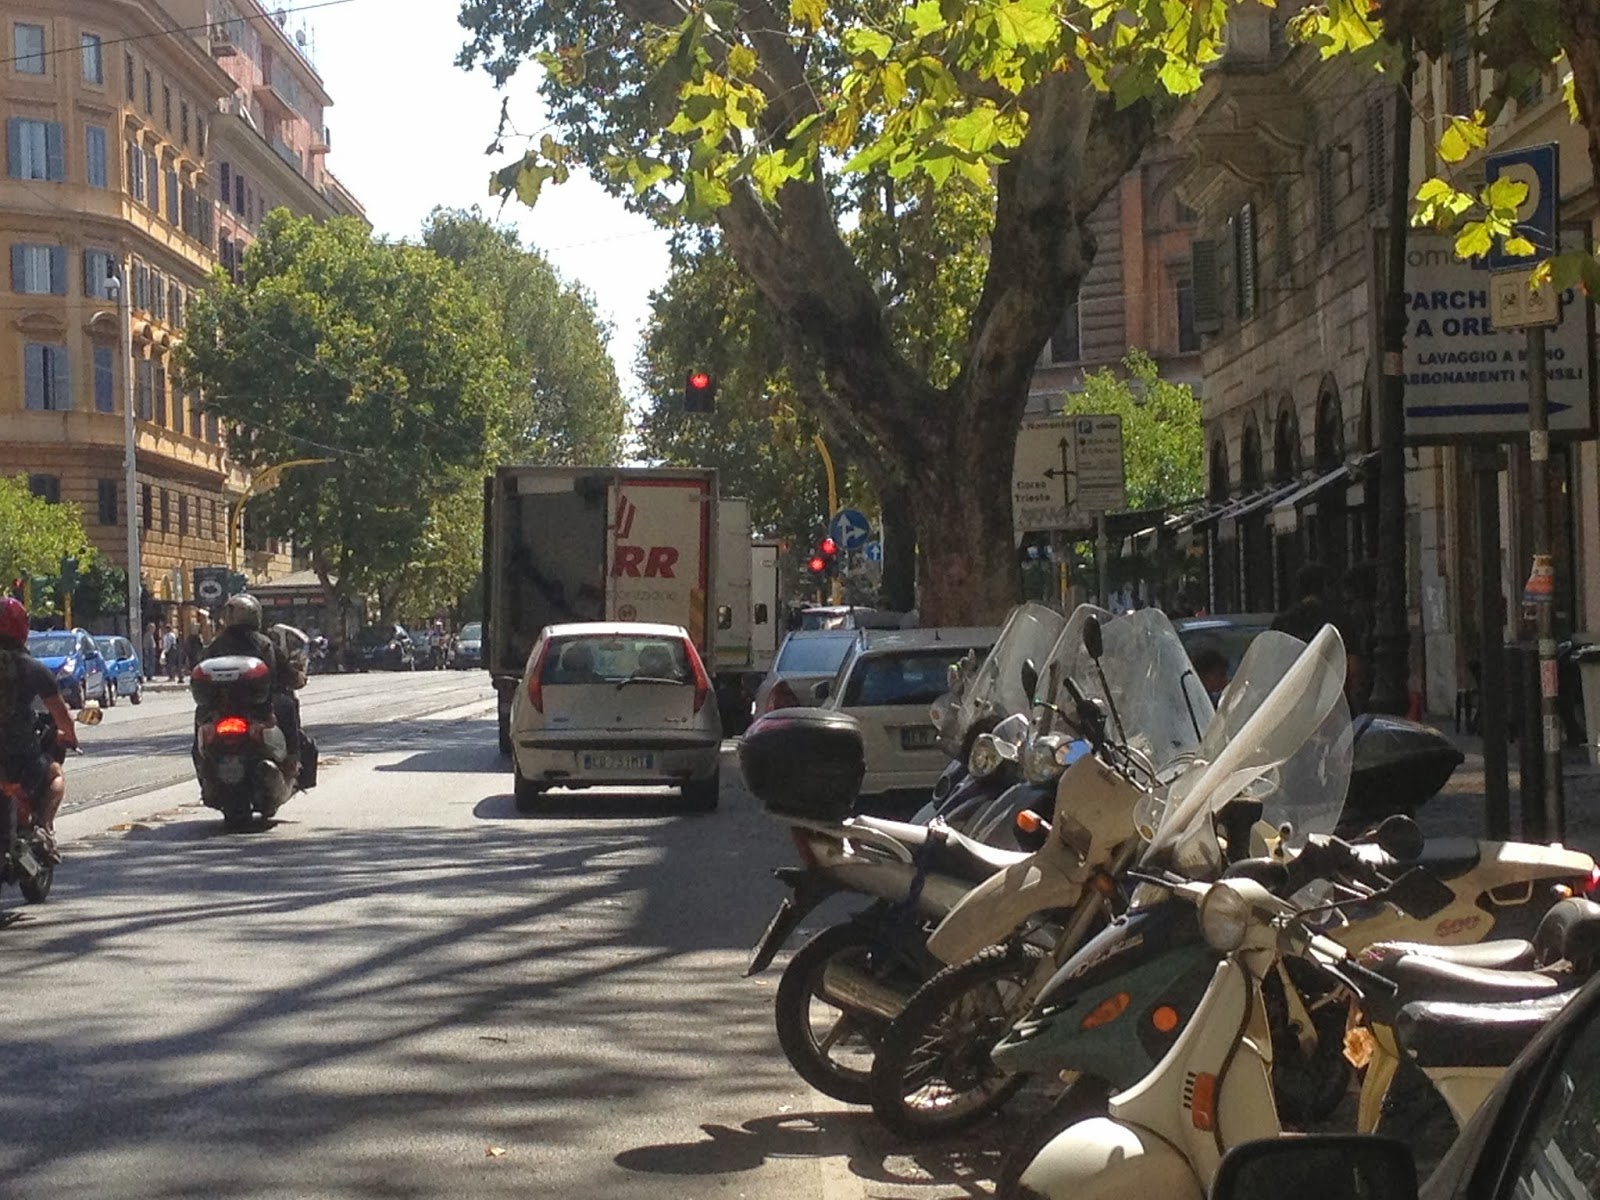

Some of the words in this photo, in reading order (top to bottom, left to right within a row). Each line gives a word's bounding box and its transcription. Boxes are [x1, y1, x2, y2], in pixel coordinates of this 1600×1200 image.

[1415, 318, 1433, 337] A
[1417, 350, 1497, 366] LAVAGGIO
[1502, 350, 1513, 362] A
[1518, 348, 1565, 362] MNO
[1402, 369, 1515, 386] ABBONAMENTI
[1016, 481, 1047, 490] Corso
[1014, 493, 1051, 503] Trieste
